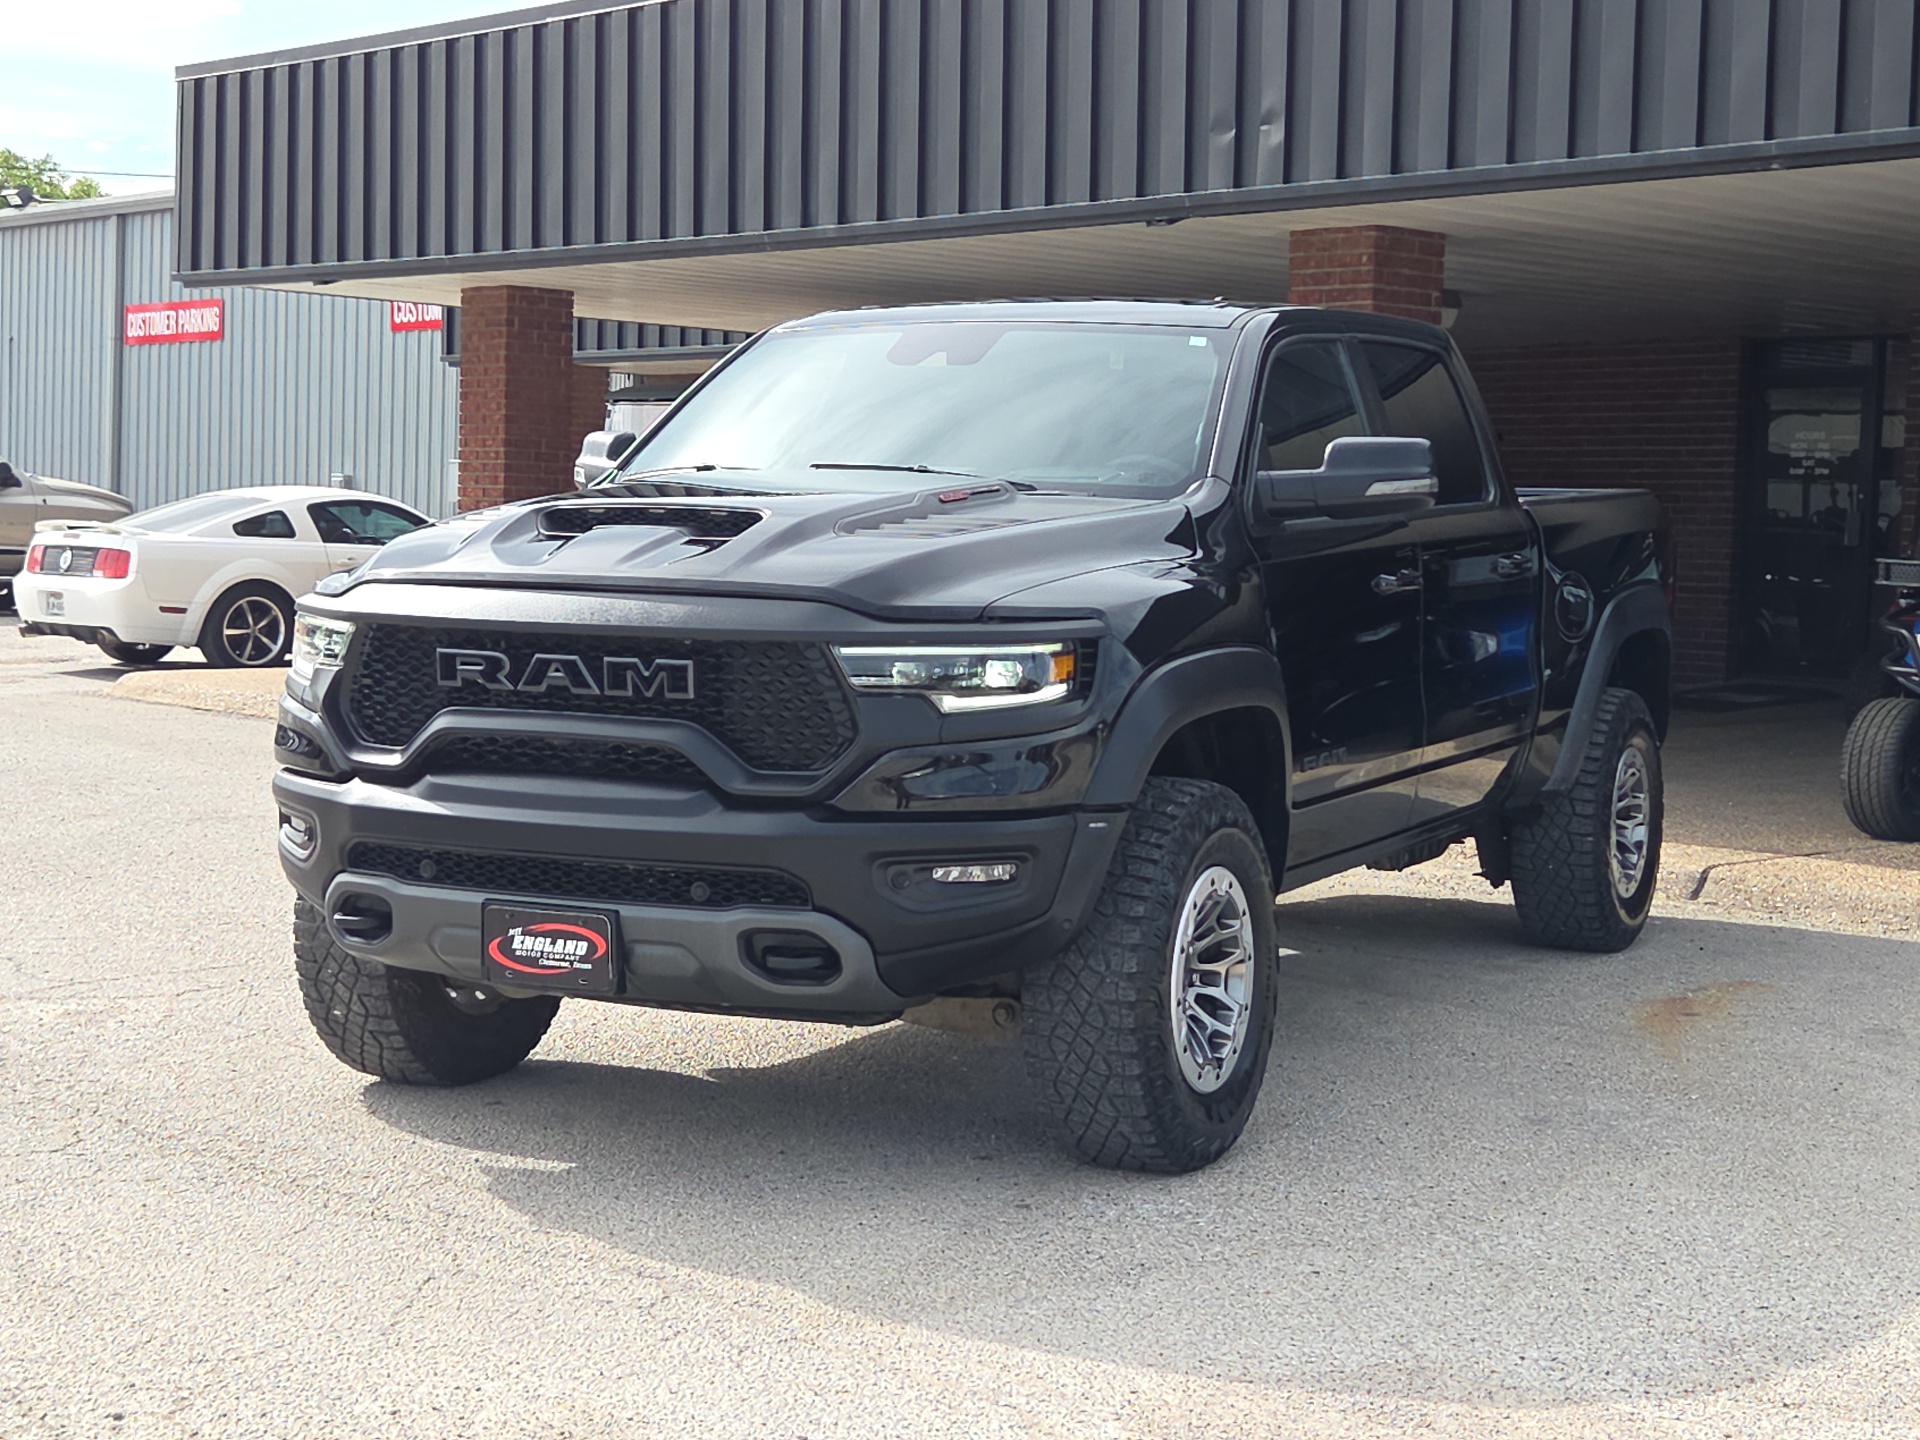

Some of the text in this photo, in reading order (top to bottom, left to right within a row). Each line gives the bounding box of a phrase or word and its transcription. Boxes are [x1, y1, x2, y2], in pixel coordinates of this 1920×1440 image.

[127, 306, 220, 338] CUSTOMER PARKING
[436, 648, 694, 699] RAM
[511, 935, 589, 956] ENGLAND
[515, 950, 580, 961] MOTOR COMPANY
